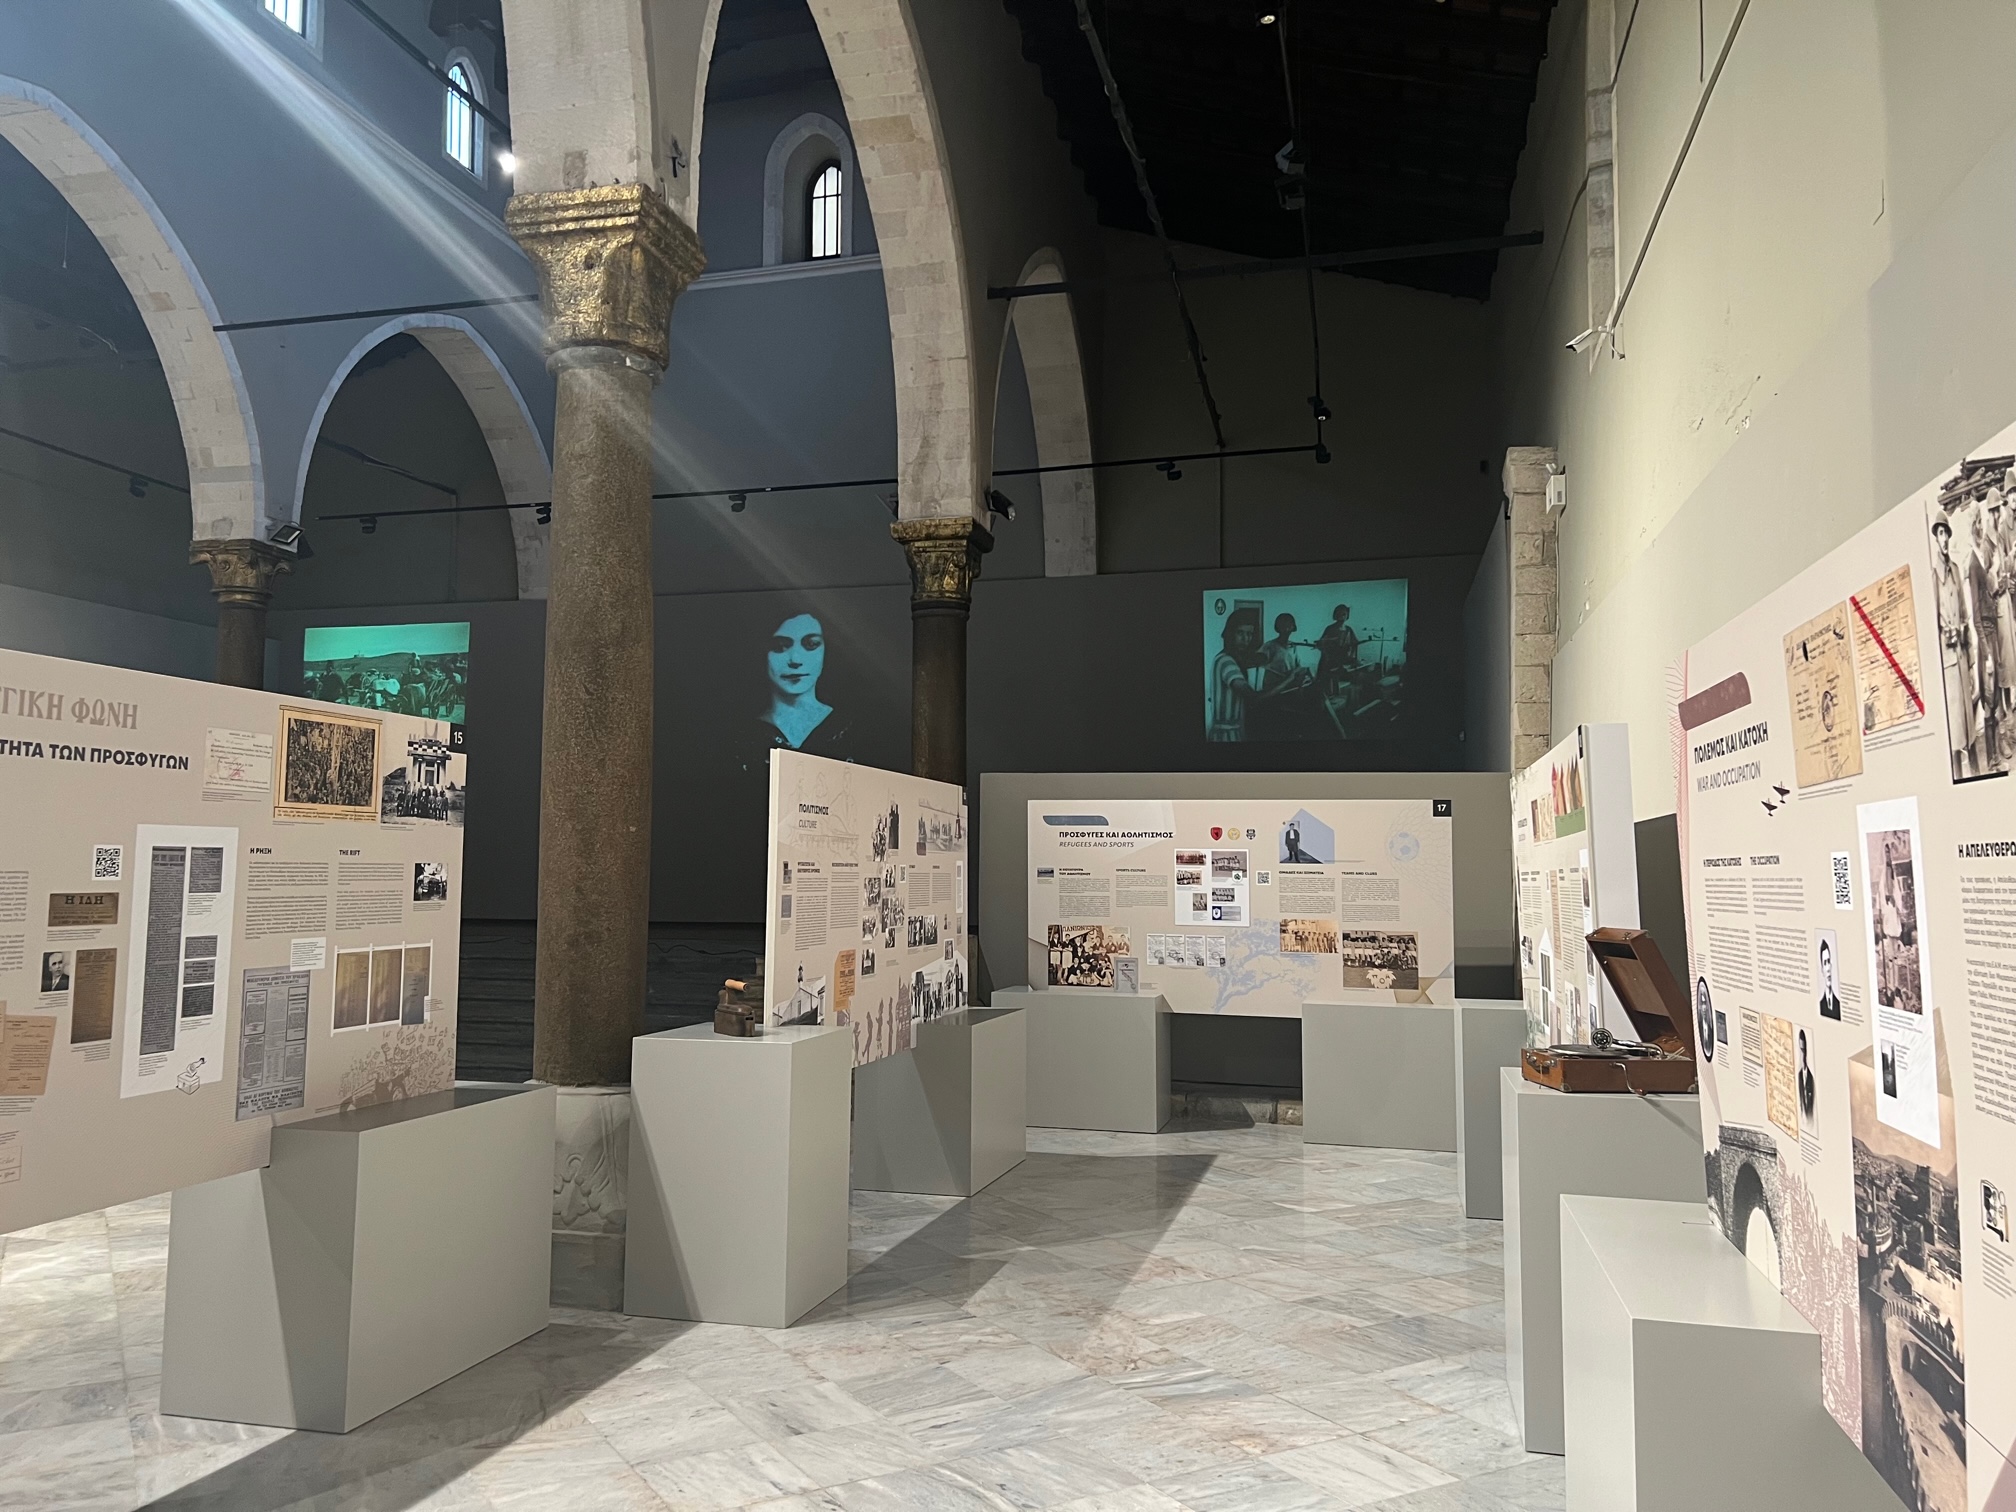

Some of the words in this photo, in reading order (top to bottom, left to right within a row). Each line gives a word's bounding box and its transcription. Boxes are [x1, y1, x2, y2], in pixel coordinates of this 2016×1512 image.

[0, 685, 65, 721] ΓΙΚΗ
[71, 697, 138, 730] ΦΩΝΗ
[453, 731, 463, 744] 15
[1694, 737, 1726, 764] ΠΟΛΕΜΟΣ
[1725, 733, 1738, 754] ΚΑΙ
[1738, 721, 1769, 750] ΚΑΤΟΧΗ
[49, 743, 86, 762] ΤΩΝ
[90, 747, 190, 770] ΠΡΟΣΦΥΓΩΝ
[1696, 776, 1709, 793] WAR
[1709, 772, 1722, 790] AND
[1722, 760, 1761, 786] OCCUPATION
[1437, 804, 1447, 812] 17
[1958, 844, 1965, 858] Η
[64, 895, 75, 905] Η
